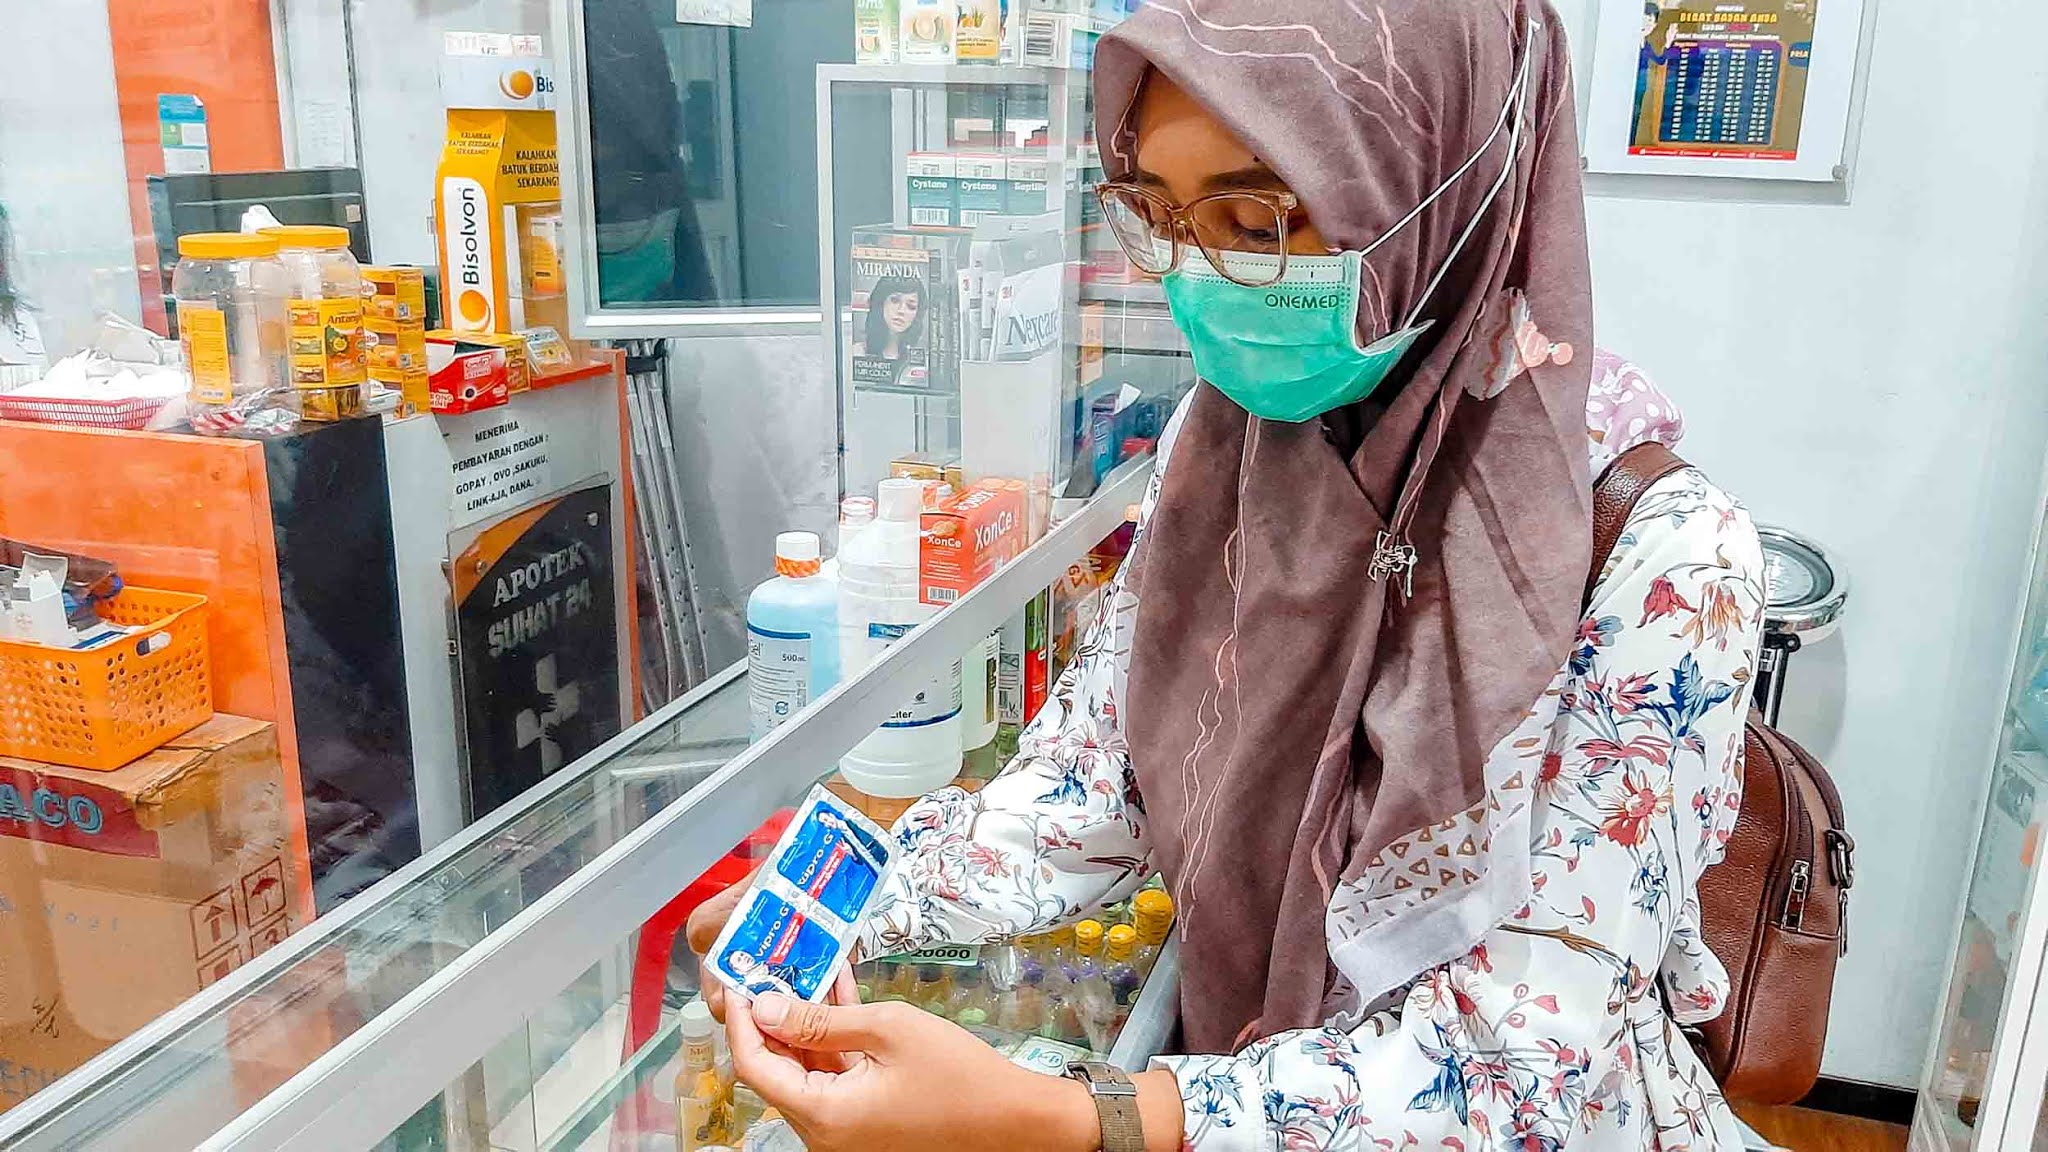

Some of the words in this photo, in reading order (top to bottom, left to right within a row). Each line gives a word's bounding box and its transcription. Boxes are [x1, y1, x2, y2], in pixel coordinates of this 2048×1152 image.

[516, 150, 557, 161] KALAHKAN
[502, 164, 528, 176] BATUK
[912, 180, 948, 192] Cystone
[961, 182, 998, 194] Cystone
[460, 188, 480, 286] Bisolvon
[856, 262, 921, 279] MIRANDA
[1265, 294, 1339, 309] ONEMED
[475, 420, 519, 443] MENERIMA
[452, 445, 512, 474] PEMBAYARAN
[513, 433, 544, 453] DENGAN
[456, 475, 487, 495] GOPAY
[493, 468, 511, 482] OVO
[975, 510, 1014, 553] XonCe
[927, 535, 962, 549] XonCe
[493, 541, 584, 608] APOTEK
[891, 710, 912, 719] iter
